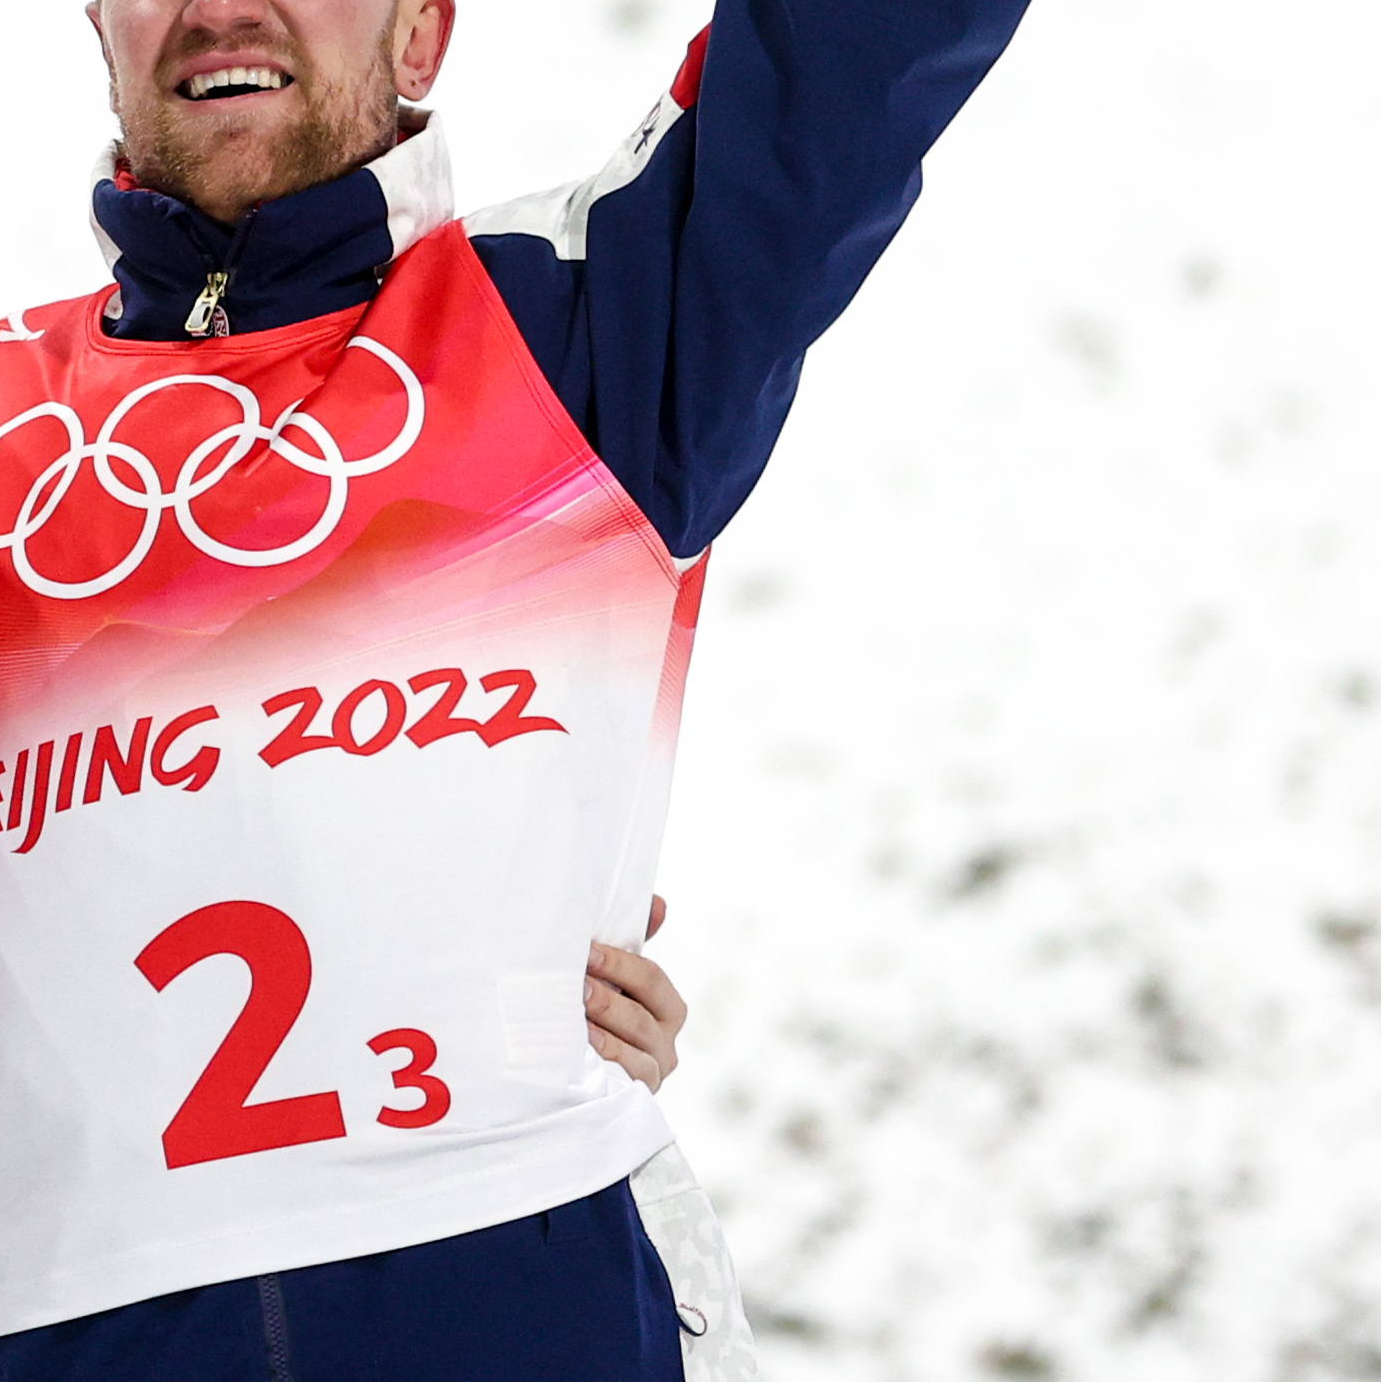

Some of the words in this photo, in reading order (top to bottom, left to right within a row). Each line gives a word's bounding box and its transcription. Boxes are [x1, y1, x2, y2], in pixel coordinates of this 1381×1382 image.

[257, 667, 570, 768] 2022
[133, 900, 347, 1170] 2
[365, 1028, 451, 1129] 3
